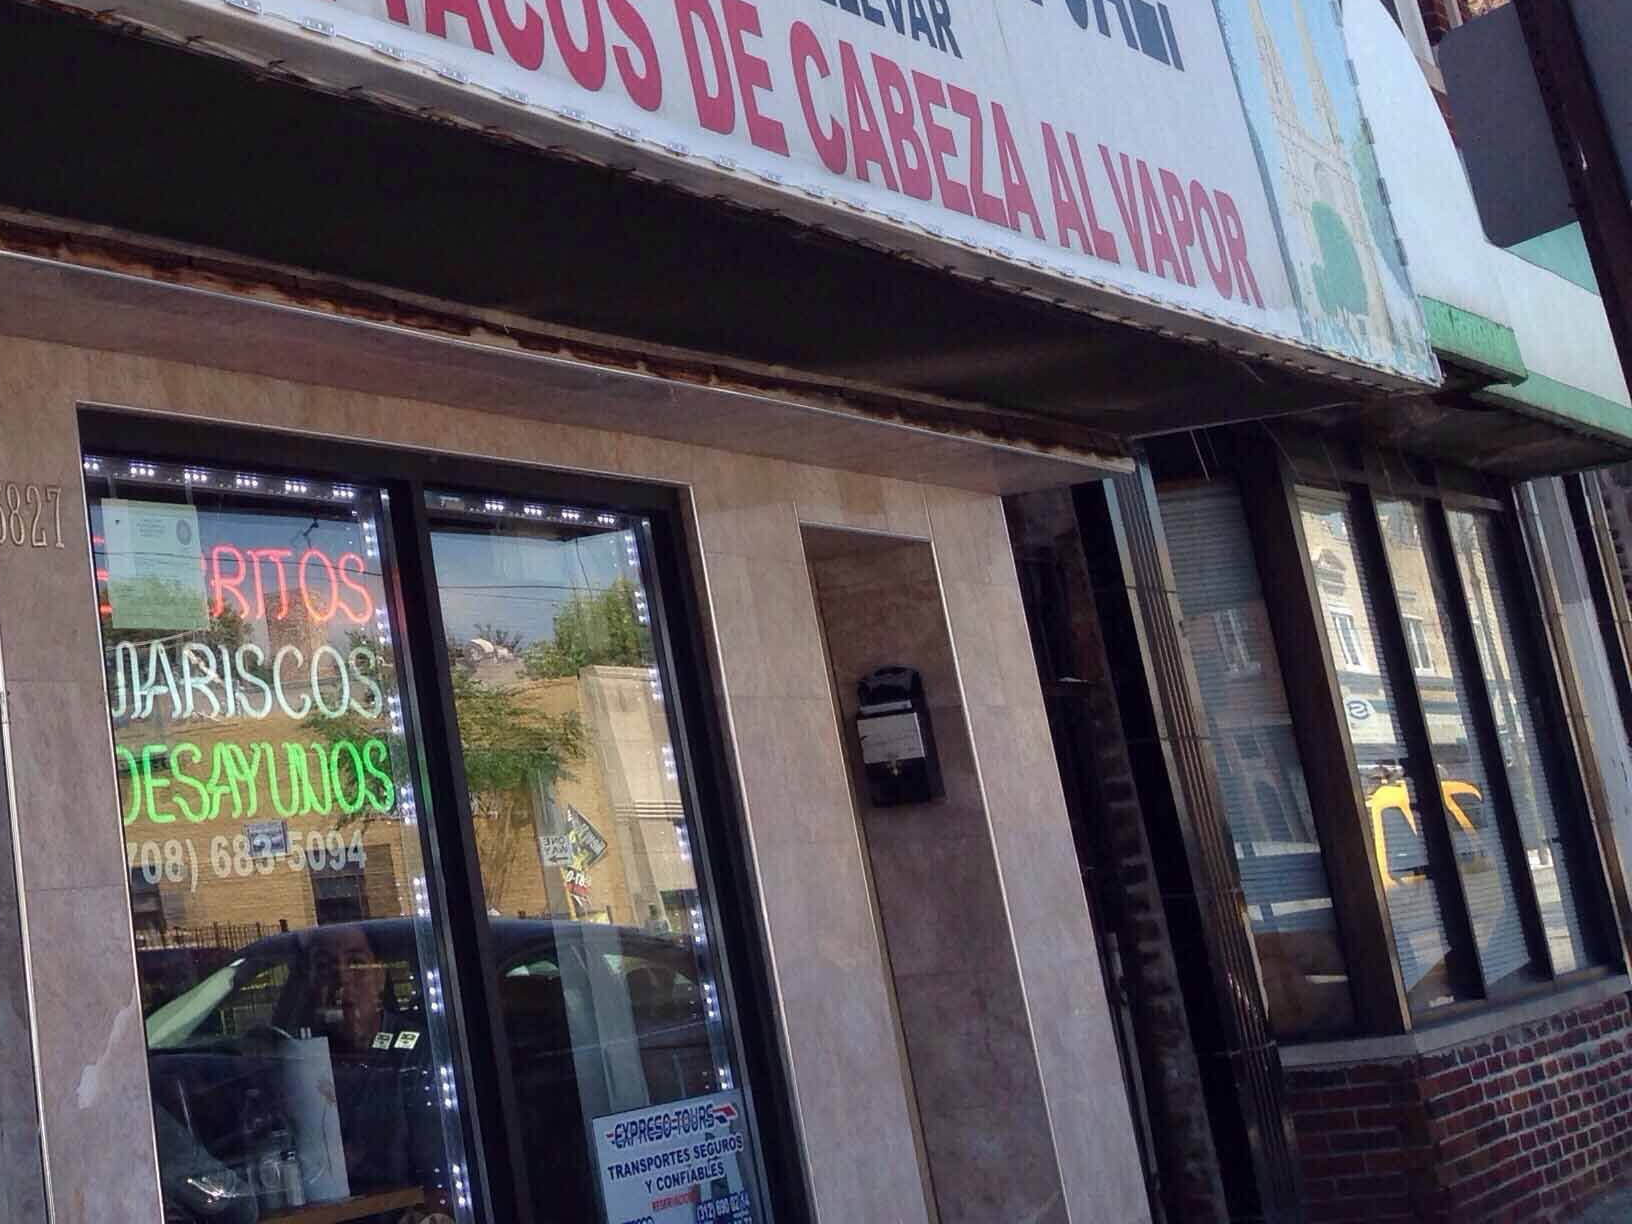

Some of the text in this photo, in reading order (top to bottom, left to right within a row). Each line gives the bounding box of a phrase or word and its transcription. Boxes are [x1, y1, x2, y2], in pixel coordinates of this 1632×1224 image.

[789, 20, 1046, 241] CABEZA
[1040, 121, 1118, 264] AL
[1097, 145, 1264, 310] VAPOR
[116, 738, 395, 825] DESAYUNOS
[126, 829, 368, 893] 708) 683-5094
[607, 1134, 744, 1181] TRANSPORTES SEGUROS
[644, 1161, 726, 1194] Y CONFIABLES
